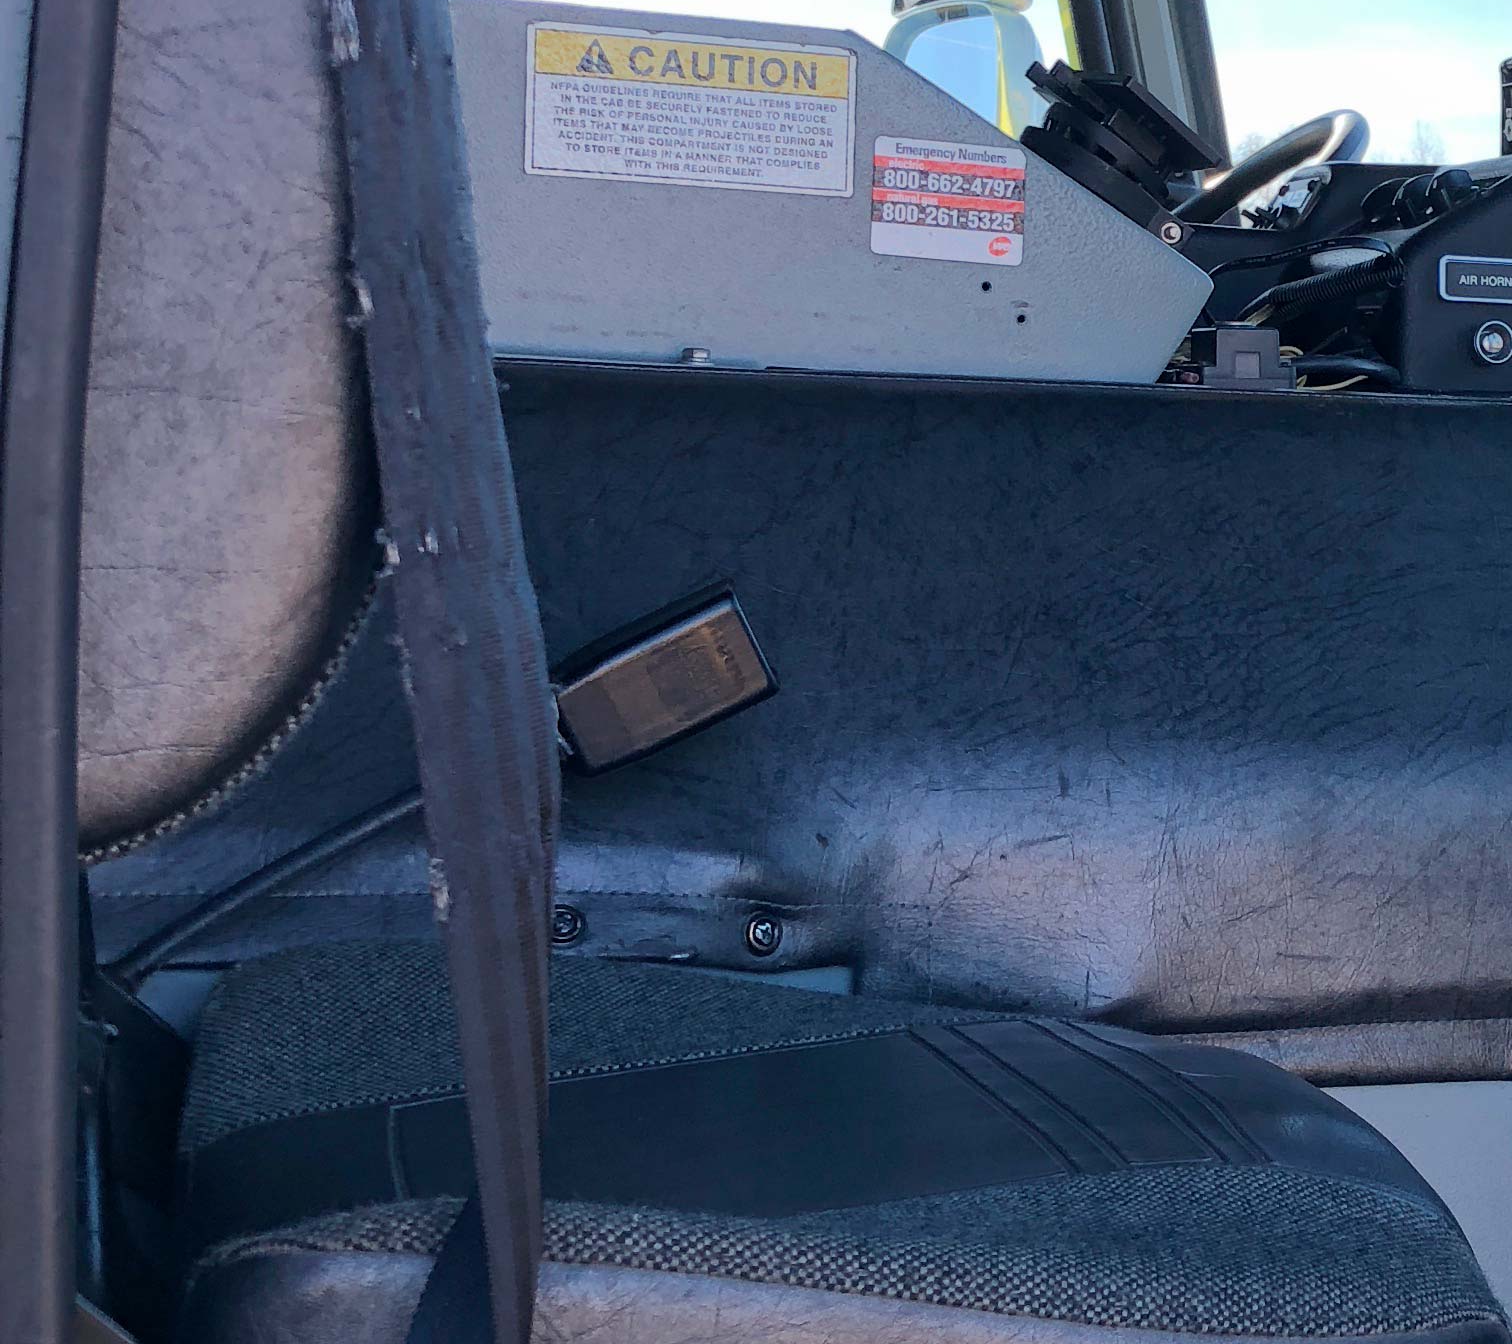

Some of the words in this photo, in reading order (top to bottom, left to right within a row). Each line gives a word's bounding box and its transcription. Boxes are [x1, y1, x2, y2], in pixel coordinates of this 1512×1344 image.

[629, 45, 818, 90] CAUTION
[550, 81, 580, 92] NFPA
[582, 83, 649, 98] GUIDELINES
[652, 88, 701, 102] REQUIRE
[705, 94, 732, 105] THAT
[735, 96, 756, 107] ALL
[759, 98, 791, 109] ITEMS
[794, 101, 838, 113] STORED
[560, 93, 572, 103] IN
[576, 95, 597, 105] THE
[600, 96, 624, 108] CAB
[627, 99, 642, 109] BE
[646, 101, 705, 114] SECURELY
[706, 106, 762, 119] FASTENED
[766, 111, 780, 121] TO
[783, 112, 828, 124] REDUCE
[553, 117, 586, 129] ITEMS
[590, 120, 618, 131] THAT
[621, 122, 644, 132] MAY
[647, 124, 695, 137] BECOME
[697, 129, 772, 143] PROJECTILES
[775, 135, 816, 147] DURING
[819, 138, 834, 148] AN
[554, 105, 575, 116] THE
[579, 107, 605, 118] RISK
[609, 110, 624, 119] OF
[627, 111, 687, 125] PERSONAL
[689, 116, 728, 128] INJURY
[732, 120, 776, 132] CAUSED
[779, 123, 794, 133] BY
[797, 125, 833, 137] LOOSE
[558, 129, 617, 142] ACCIDENT.
[620, 133, 645, 145] THIS
[648, 137, 732, 152] COMPARTMENT
[734, 143, 745, 153] IS
[748, 145, 769, 155] NOT
[773, 147, 828, 159] DESIGNED
[565, 142, 581, 152] TO
[584, 143, 621, 155] STORE
[624, 147, 658, 158] ITEMS
[660, 149, 672, 159] IN
[675, 151, 683, 160] A
[685, 152, 732, 163] MANNER
[735, 155, 763, 166] THAT
[766, 157, 821, 170] COMPLIES
[895, 142, 957, 161] Emergency
[958, 148, 1008, 165] Numbers
[623, 158, 651, 169] WITH
[655, 161, 680, 172] THIS
[683, 163, 765, 178] REQUIREMENT.
[883, 169, 1017, 199] 800-662-4797
[882, 202, 1015, 232] 800-261-5325
[1459, 274, 1478, 286] AIR
[1480, 275, 1512, 288] HORN
